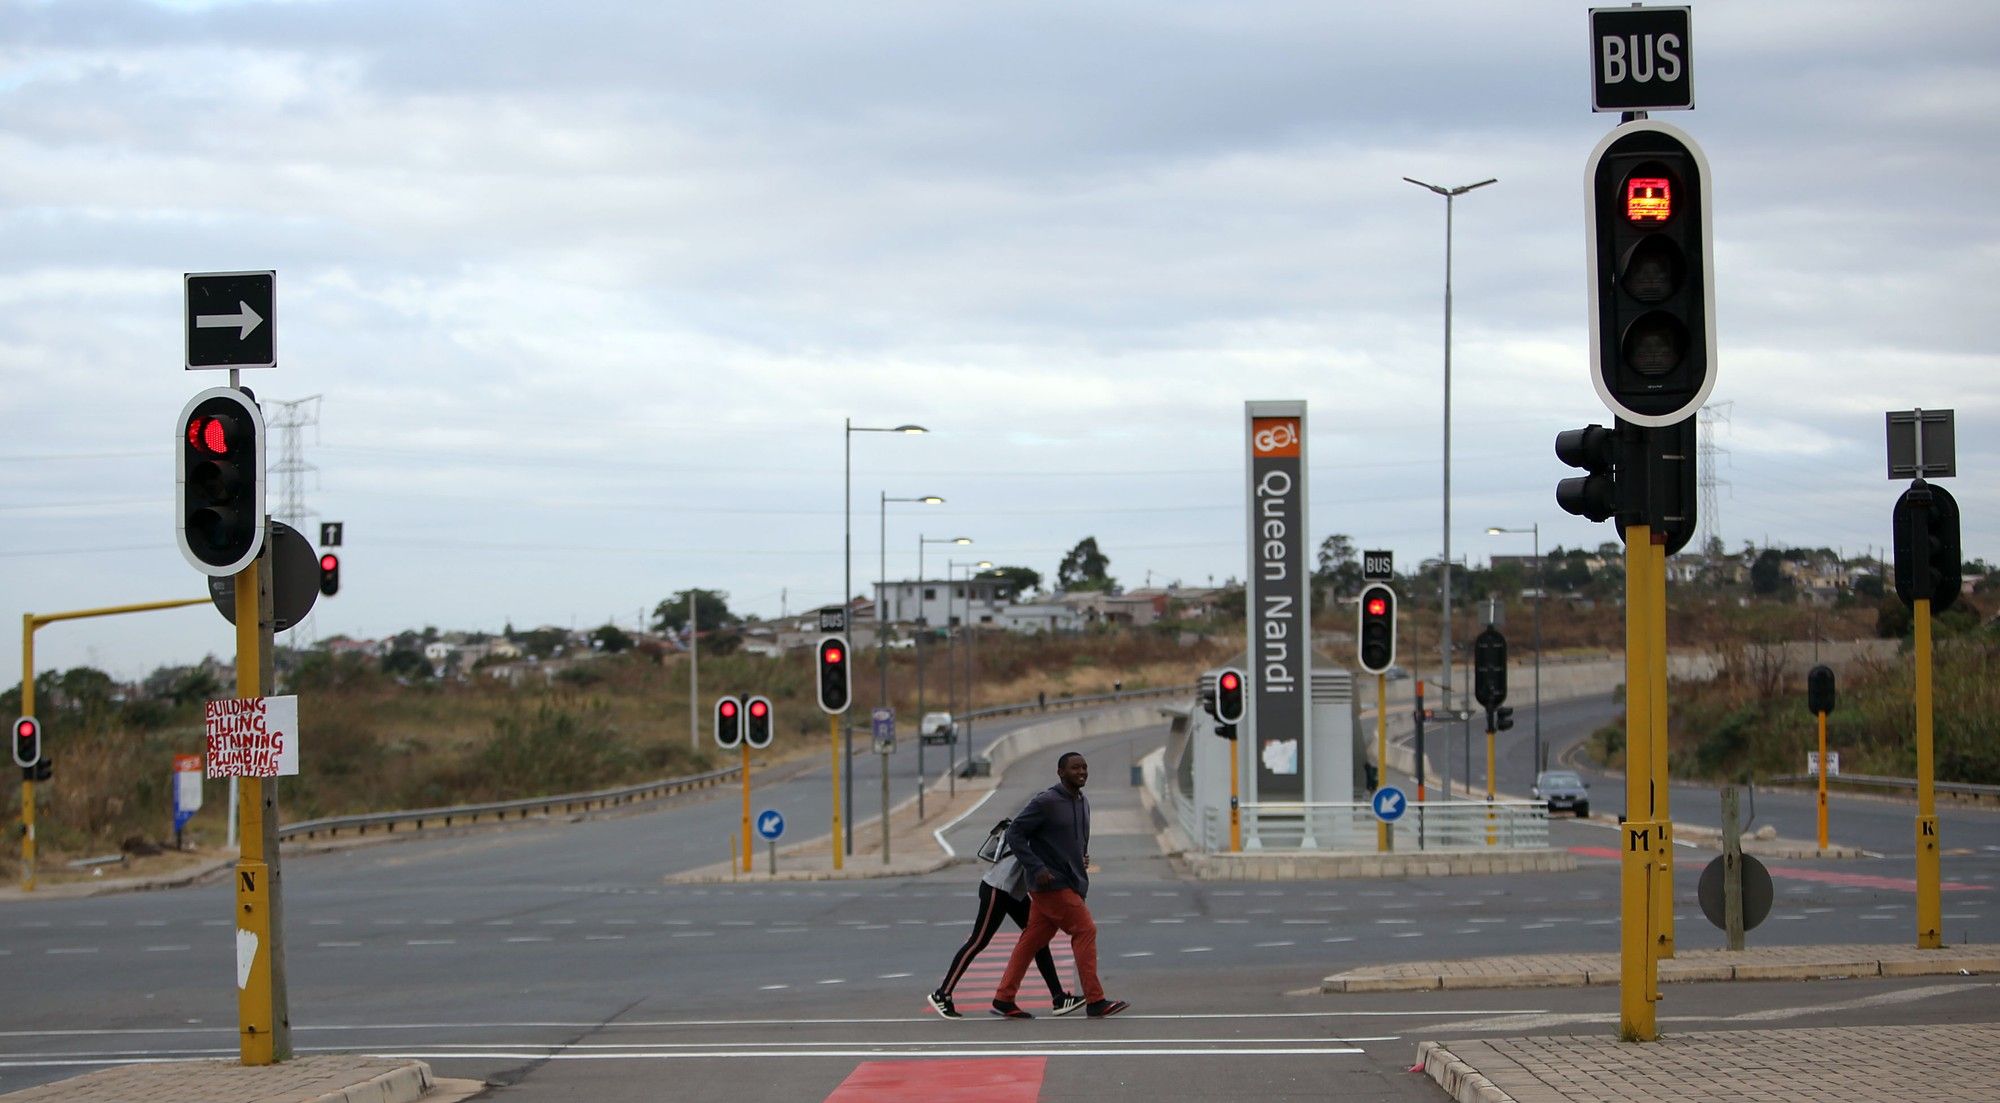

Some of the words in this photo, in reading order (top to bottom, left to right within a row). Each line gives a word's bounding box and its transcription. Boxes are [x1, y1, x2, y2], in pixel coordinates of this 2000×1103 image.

[1602, 32, 1681, 84] BUS
[1257, 470, 1292, 580] Queen
[1366, 556, 1391, 573] BUS
[821, 612, 843, 628] BUS
[1265, 596, 1294, 693] Nandi
[206, 697, 266, 718] BUILDING
[206, 715, 266, 736] TILLING
[208, 749, 279, 769] PLUMBING
[1922, 821, 1935, 836] K
[1630, 829, 1650, 851] M
[240, 872, 256, 892] N
